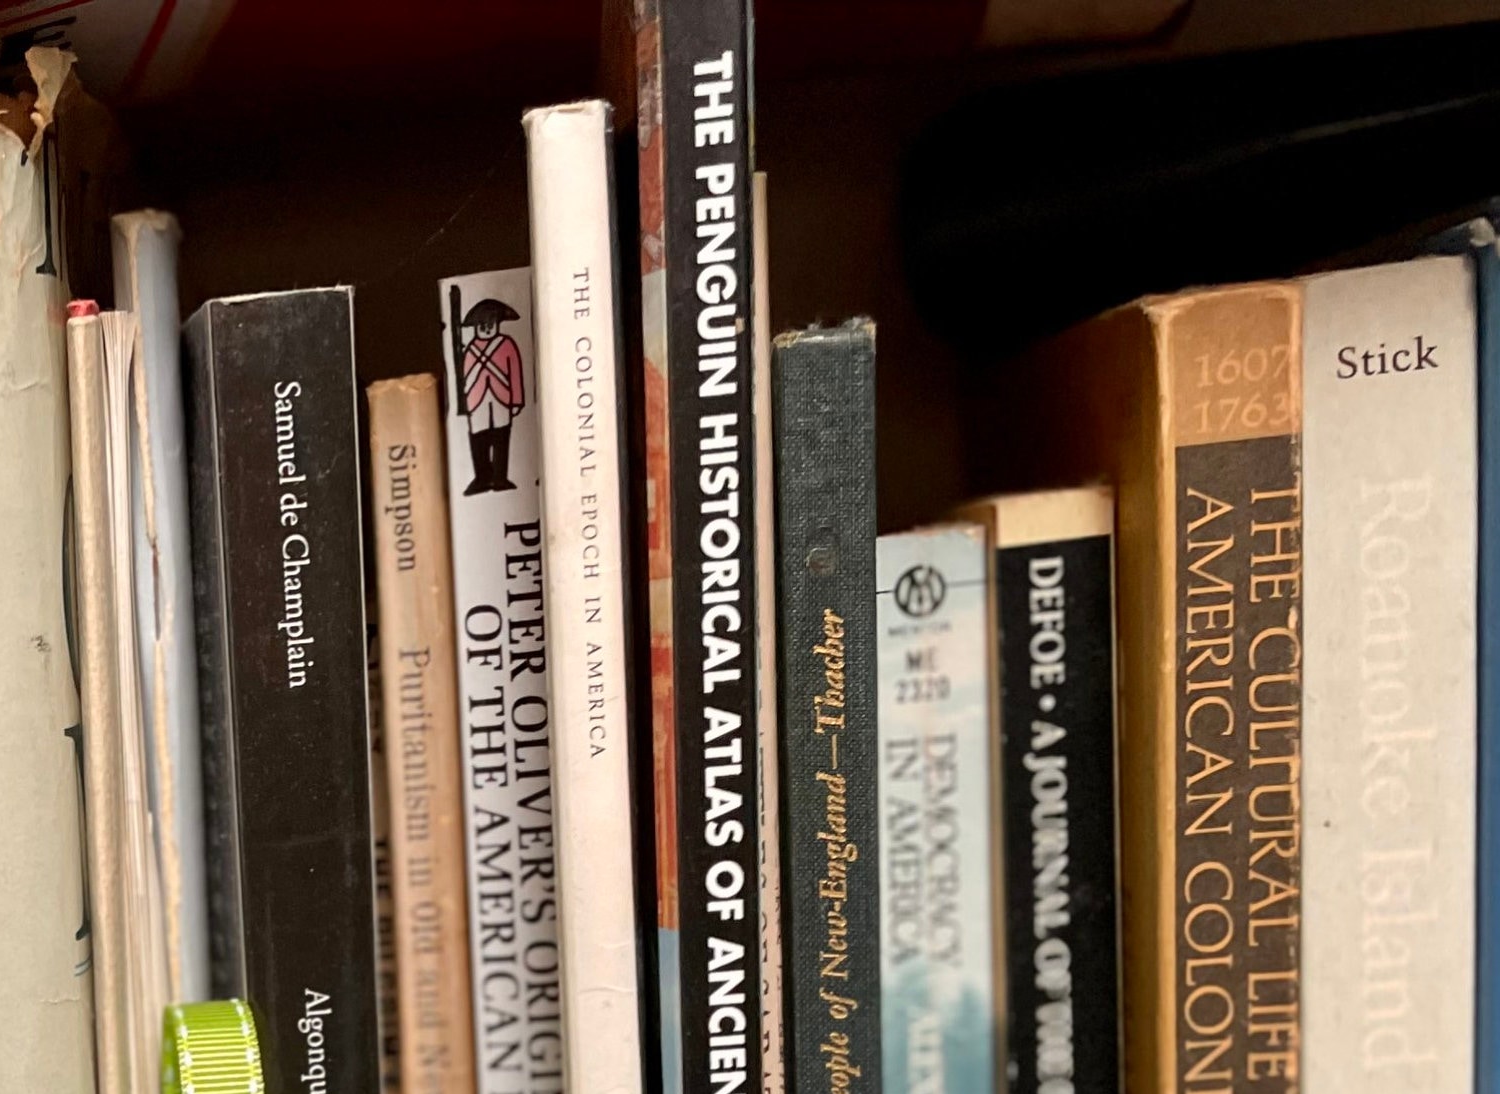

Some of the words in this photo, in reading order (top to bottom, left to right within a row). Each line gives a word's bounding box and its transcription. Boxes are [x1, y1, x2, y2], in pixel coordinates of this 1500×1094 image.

[693, 50, 736, 148] THE
[573, 267, 590, 319] THE
[695, 162, 739, 397] PENGUIN
[574, 337, 596, 477] COLONIAL
[1195, 345, 1292, 389] 1607
[1336, 335, 1439, 381] Stick
[274, 381, 306, 486] Samuel
[281, 492, 308, 526] de
[386, 444, 416, 572] Simpson
[581, 495, 601, 580] EPOCH
[699, 413, 742, 694] HISTORICAL
[1250, 486, 1301, 603] THE
[277, 533, 315, 689] Champlain
[464, 605, 504, 671] OF
[503, 519, 546, 682] PETER
[584, 598, 602, 624] IN
[1027, 556, 1067, 690] DEFOE
[1359, 474, 1437, 819] Roanoke
[587, 641, 604, 758] AMERICA
[1184, 488, 1235, 836] AMERICAN
[399, 646, 436, 843] Puritanism
[467, 685, 508, 789] THE
[702, 707, 745, 848] ATLAS
[886, 737, 921, 782] IN
[1030, 720, 1068, 750] A
[1245, 627, 1301, 948] CULTURAL
[409, 850, 435, 884] in
[511, 694, 557, 927] OLIVER'S
[1023, 755, 1072, 938] JOURNAL
[410, 899, 443, 954] Old
[474, 805, 523, 1072] AMERICAN
[704, 859, 746, 921] OF
[886, 798, 924, 966] AMERICA
[819, 989, 859, 1020] of
[1362, 846, 1439, 1071] Island
[1246, 970, 1299, 1081] LIFE
